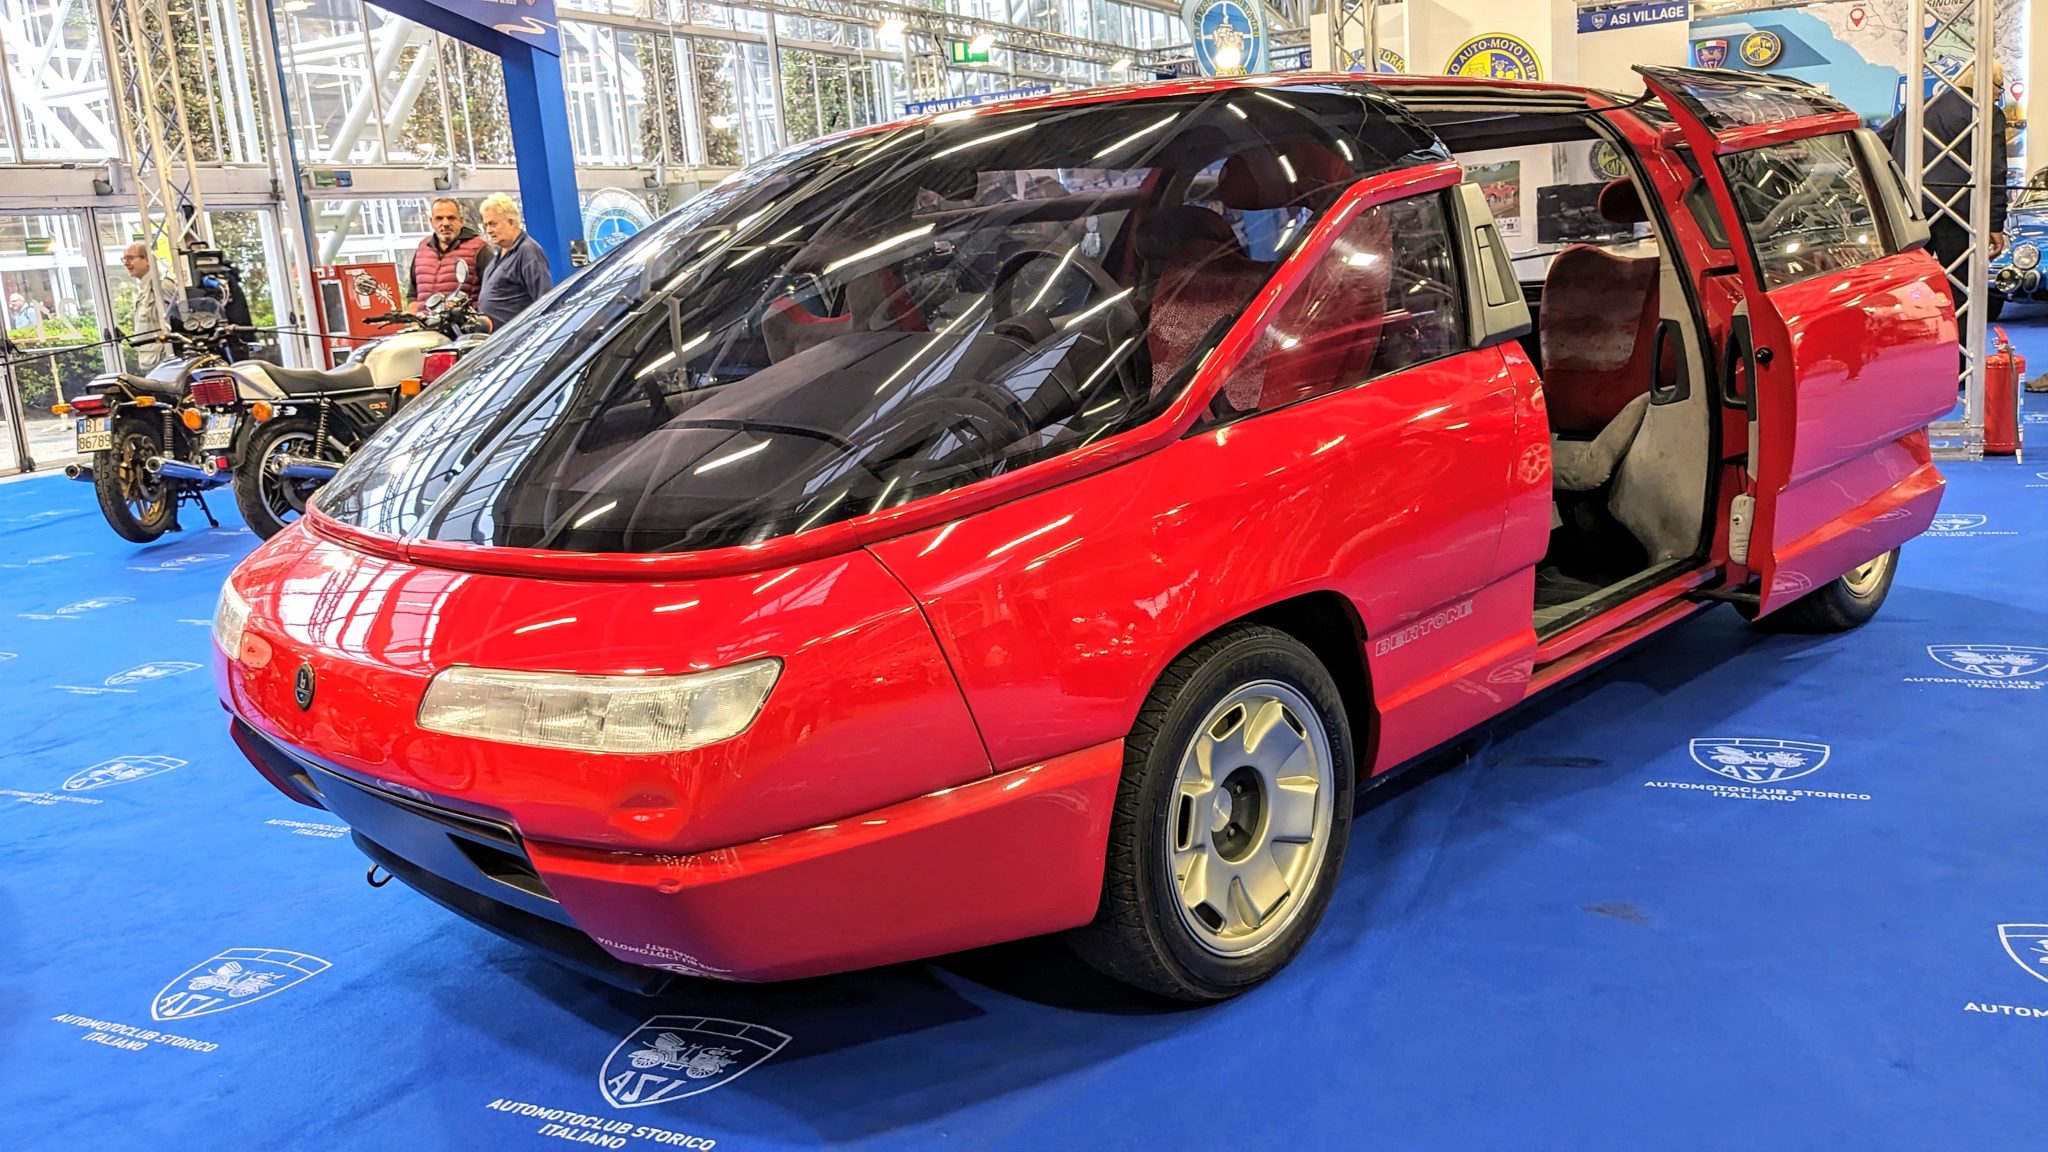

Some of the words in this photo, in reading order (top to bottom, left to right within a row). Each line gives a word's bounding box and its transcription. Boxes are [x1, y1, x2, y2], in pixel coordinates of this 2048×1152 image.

[1610, 13, 1630, 26] ASI
[1632, 5, 1685, 22] VILLAGE
[1521, 54, 1538, 80] D'EP
[921, 105, 936, 114] ASI
[79, 434, 111, 450] 86789
[1375, 600, 1473, 657] BERTONE
[1903, 677, 2034, 686] AUTOMOTOCLUB
[1719, 765, 1787, 781] ASI
[1644, 781, 1788, 795] AUTOMOTOCLUB
[1792, 789, 1872, 800] STORICO
[1713, 790, 1797, 802] ITALIANO
[158, 991, 225, 1018] ASI
[1963, 1002, 2048, 1018] AUTOM
[51, 1013, 161, 1042] AUTOMOTOCLUB
[157, 1034, 219, 1053] STORICO
[82, 1031, 148, 1051] ITALIANO
[607, 1070, 688, 1103] ASI
[486, 1098, 634, 1134] AUTOMOTOCLUB
[630, 1126, 717, 1151] STORICO
[537, 1123, 627, 1149] ITALIANO
